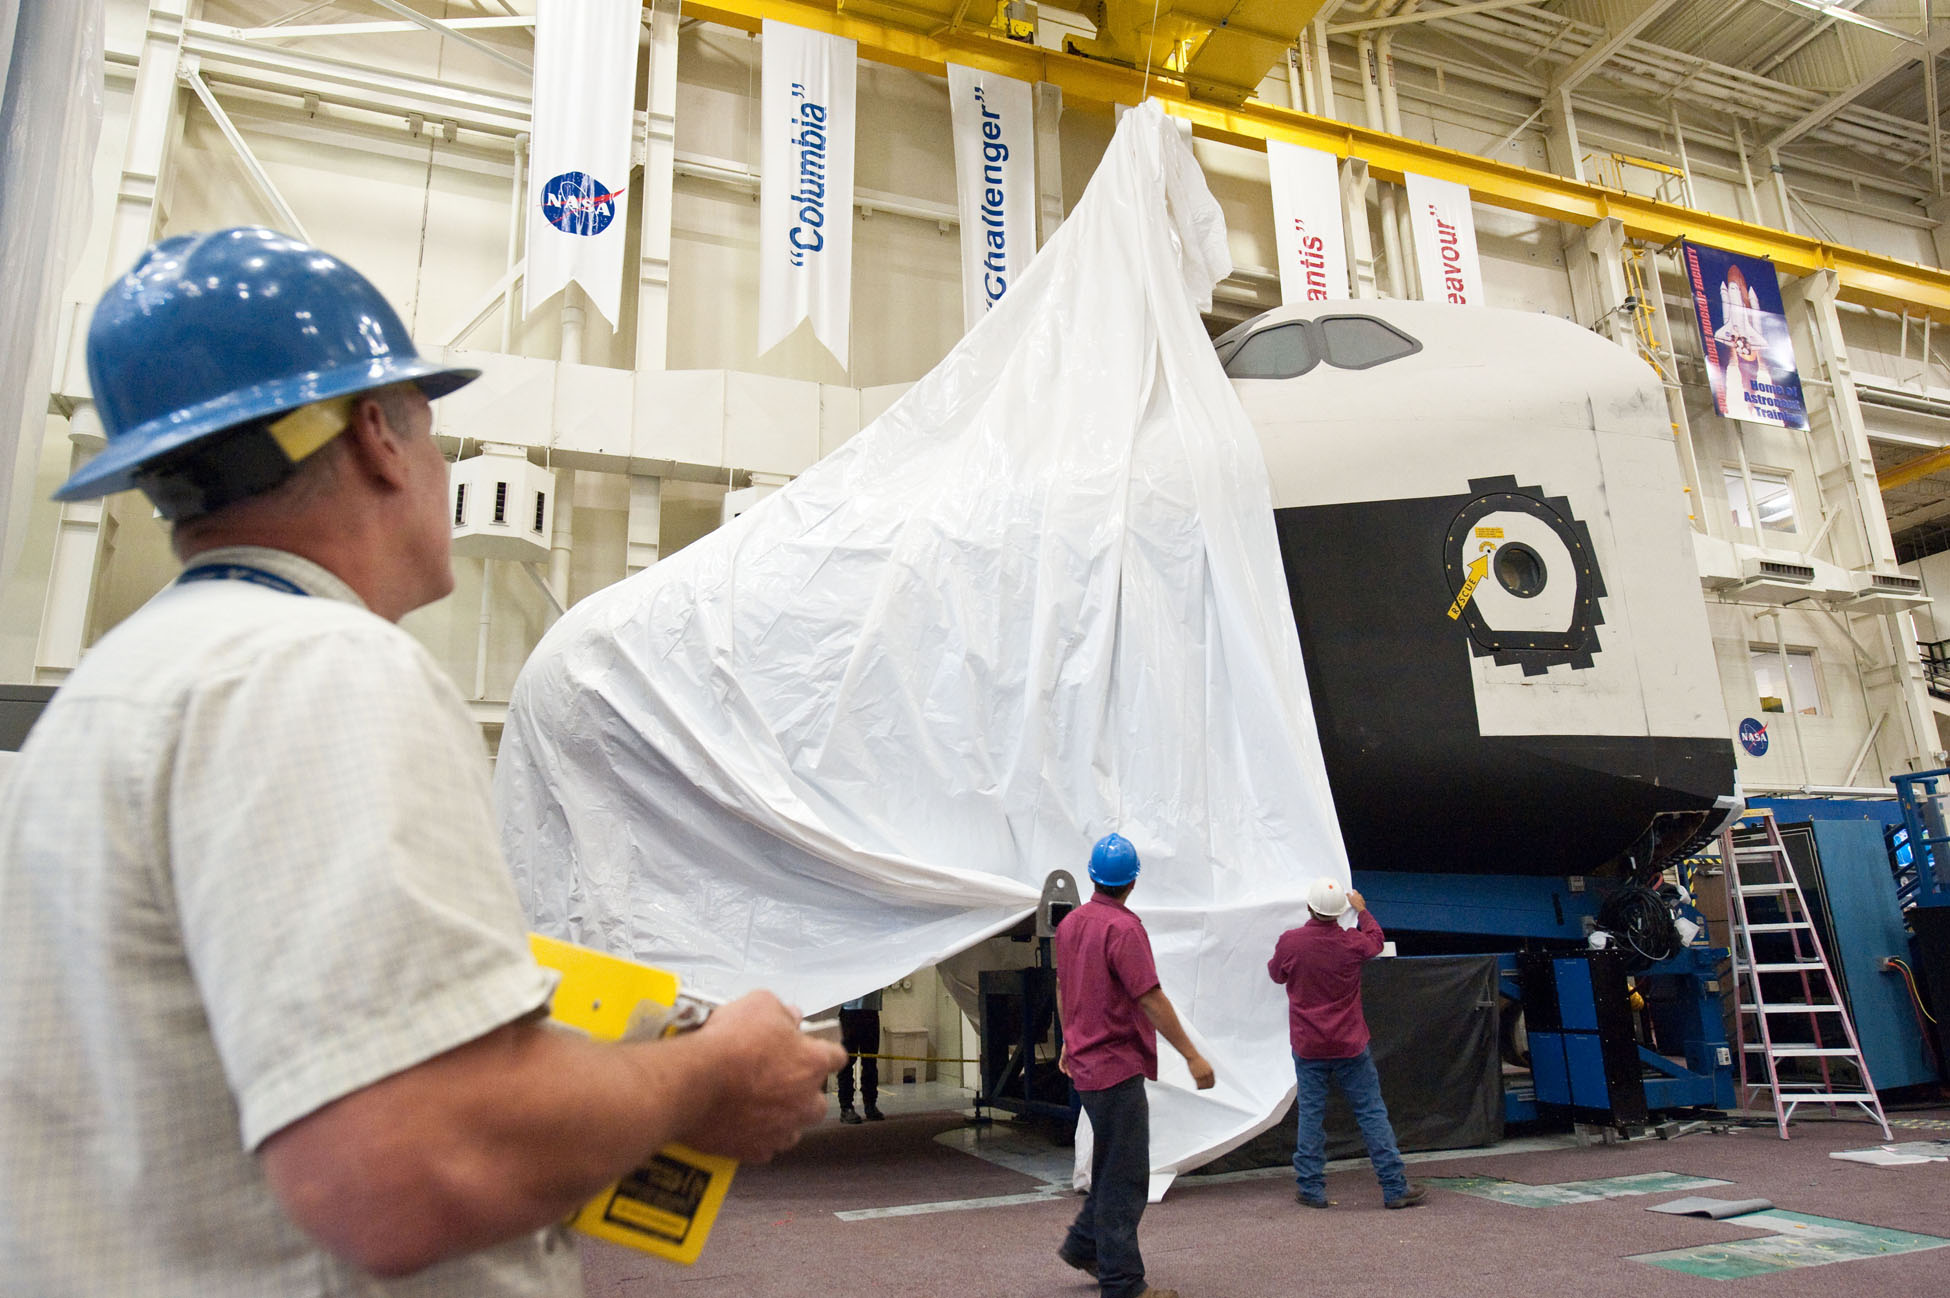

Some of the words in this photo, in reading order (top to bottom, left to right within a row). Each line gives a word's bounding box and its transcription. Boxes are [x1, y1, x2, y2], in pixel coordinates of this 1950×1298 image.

[546, 192, 611, 217] NASA
[1686, 245, 1705, 291] FACILITY
[1749, 379, 1785, 396] Home
[1753, 406, 1804, 426] Traini
